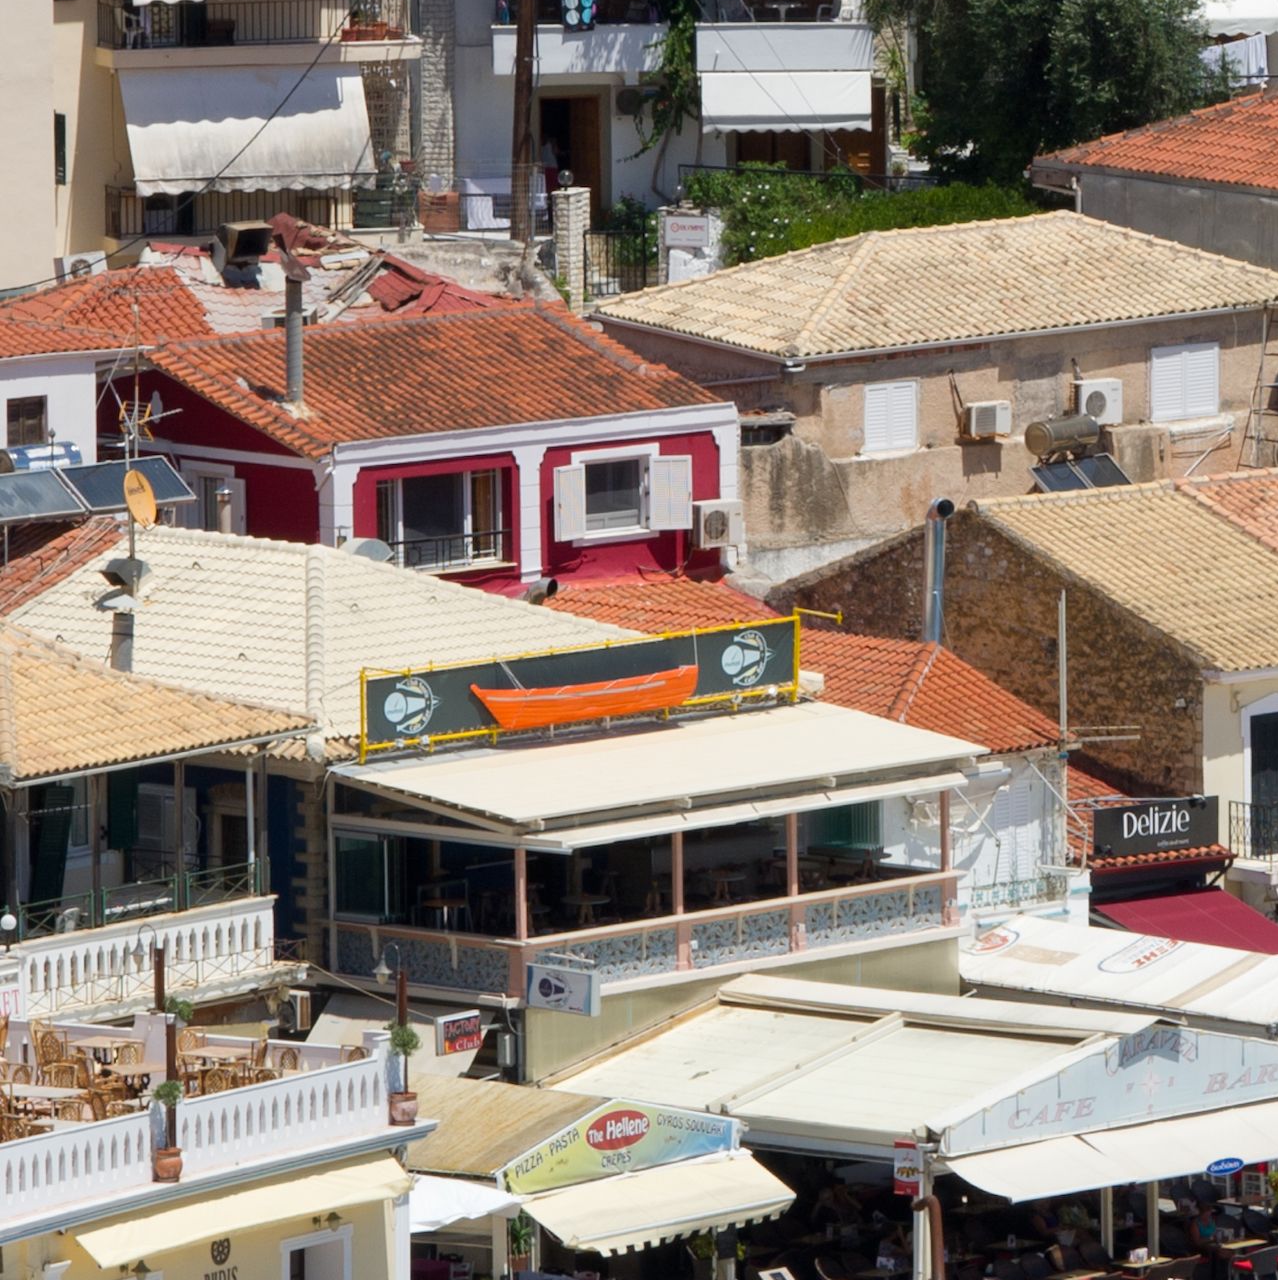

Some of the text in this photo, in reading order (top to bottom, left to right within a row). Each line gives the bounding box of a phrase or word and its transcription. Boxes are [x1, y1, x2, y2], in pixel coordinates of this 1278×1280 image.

[1123, 804, 1190, 839] Delizie
[456, 1039, 482, 1051] Club
[656, 1113, 684, 1130] GYROS
[1007, 1096, 1098, 1130] CAFE
[587, 1117, 649, 1143] The Hellene
[515, 1152, 543, 1179] PIZZA
[549, 1128, 581, 1156] PASTA
